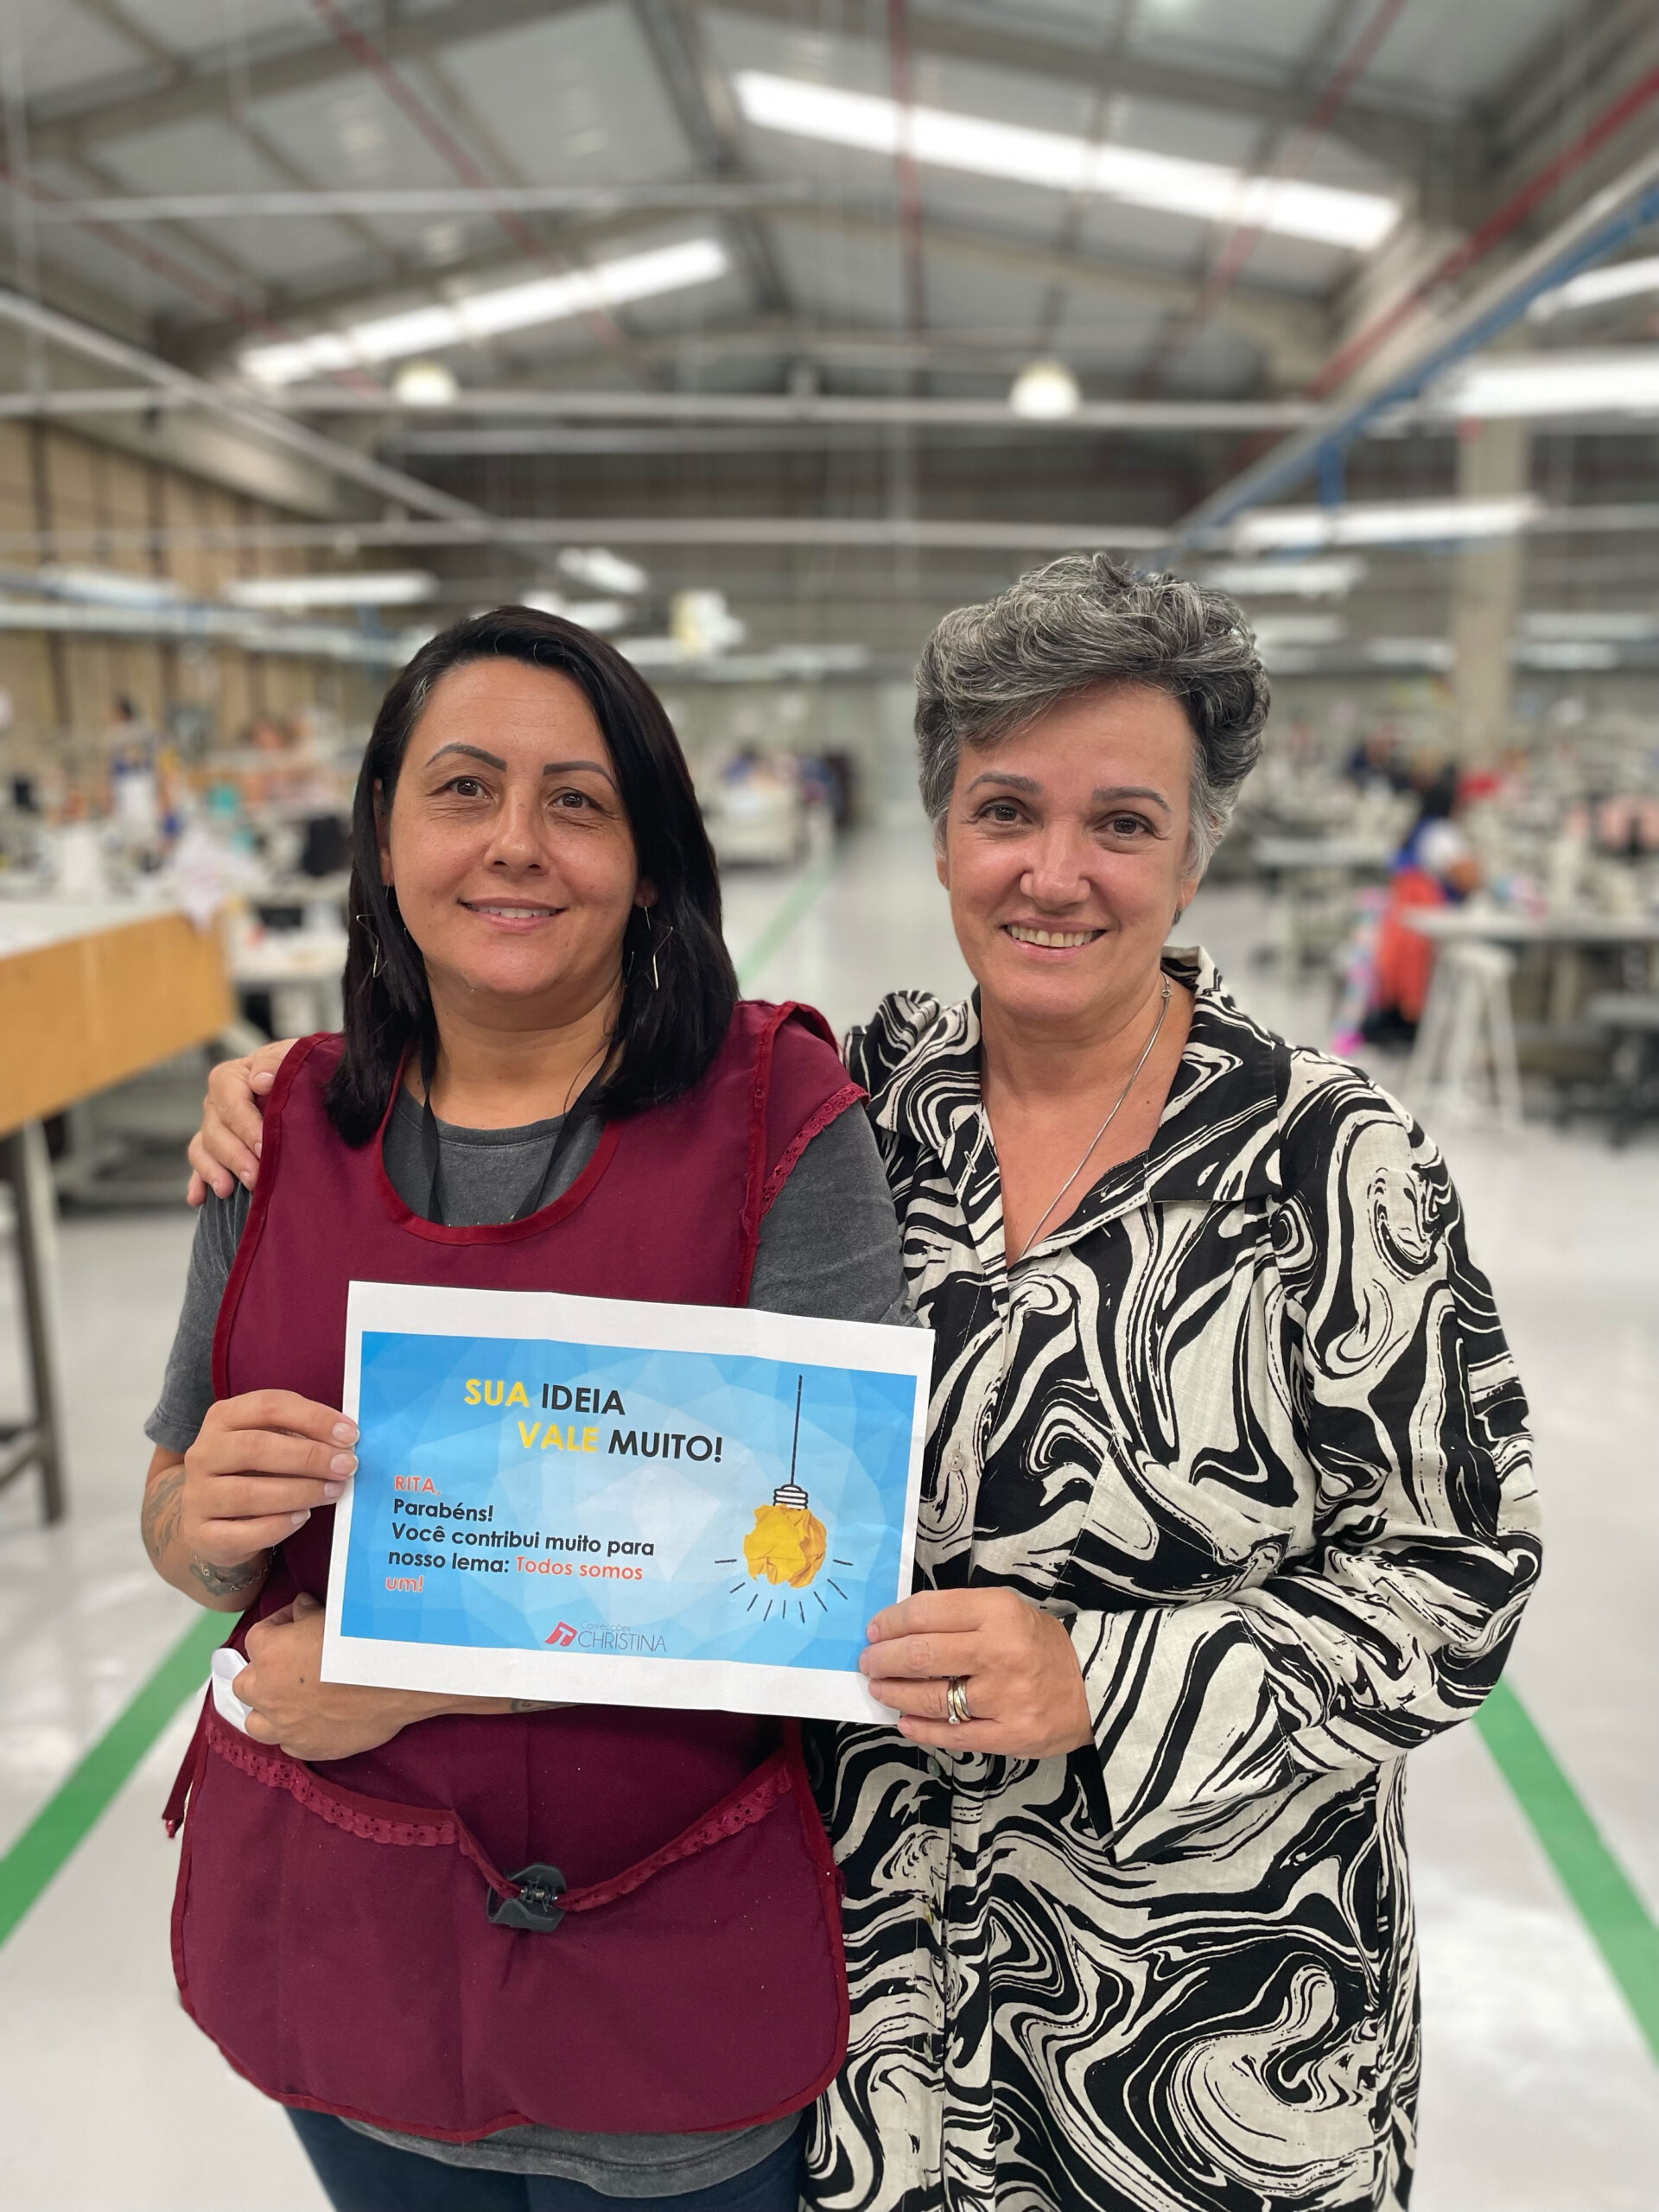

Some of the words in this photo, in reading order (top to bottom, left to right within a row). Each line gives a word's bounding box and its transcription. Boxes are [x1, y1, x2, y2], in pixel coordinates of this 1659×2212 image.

[464, 1378, 531, 1408] SUA
[541, 1382, 626, 1415] IDEIA
[518, 1421, 599, 1453] VALE
[608, 1429, 723, 1463] MUITO!
[394, 1475, 441, 1497] RITA,
[393, 1498, 494, 1522] Parabéns!
[391, 1522, 446, 1543] Você
[451, 1530, 540, 1548] contribui
[544, 1534, 601, 1554] muito
[607, 1540, 655, 1558] para
[388, 1551, 446, 1569] nosso
[451, 1553, 510, 1573] lema:
[516, 1555, 573, 1576] Todos
[579, 1564, 643, 1580] somos
[385, 1575, 423, 1593] um!
[577, 1630, 667, 1653] CHRISTINA
